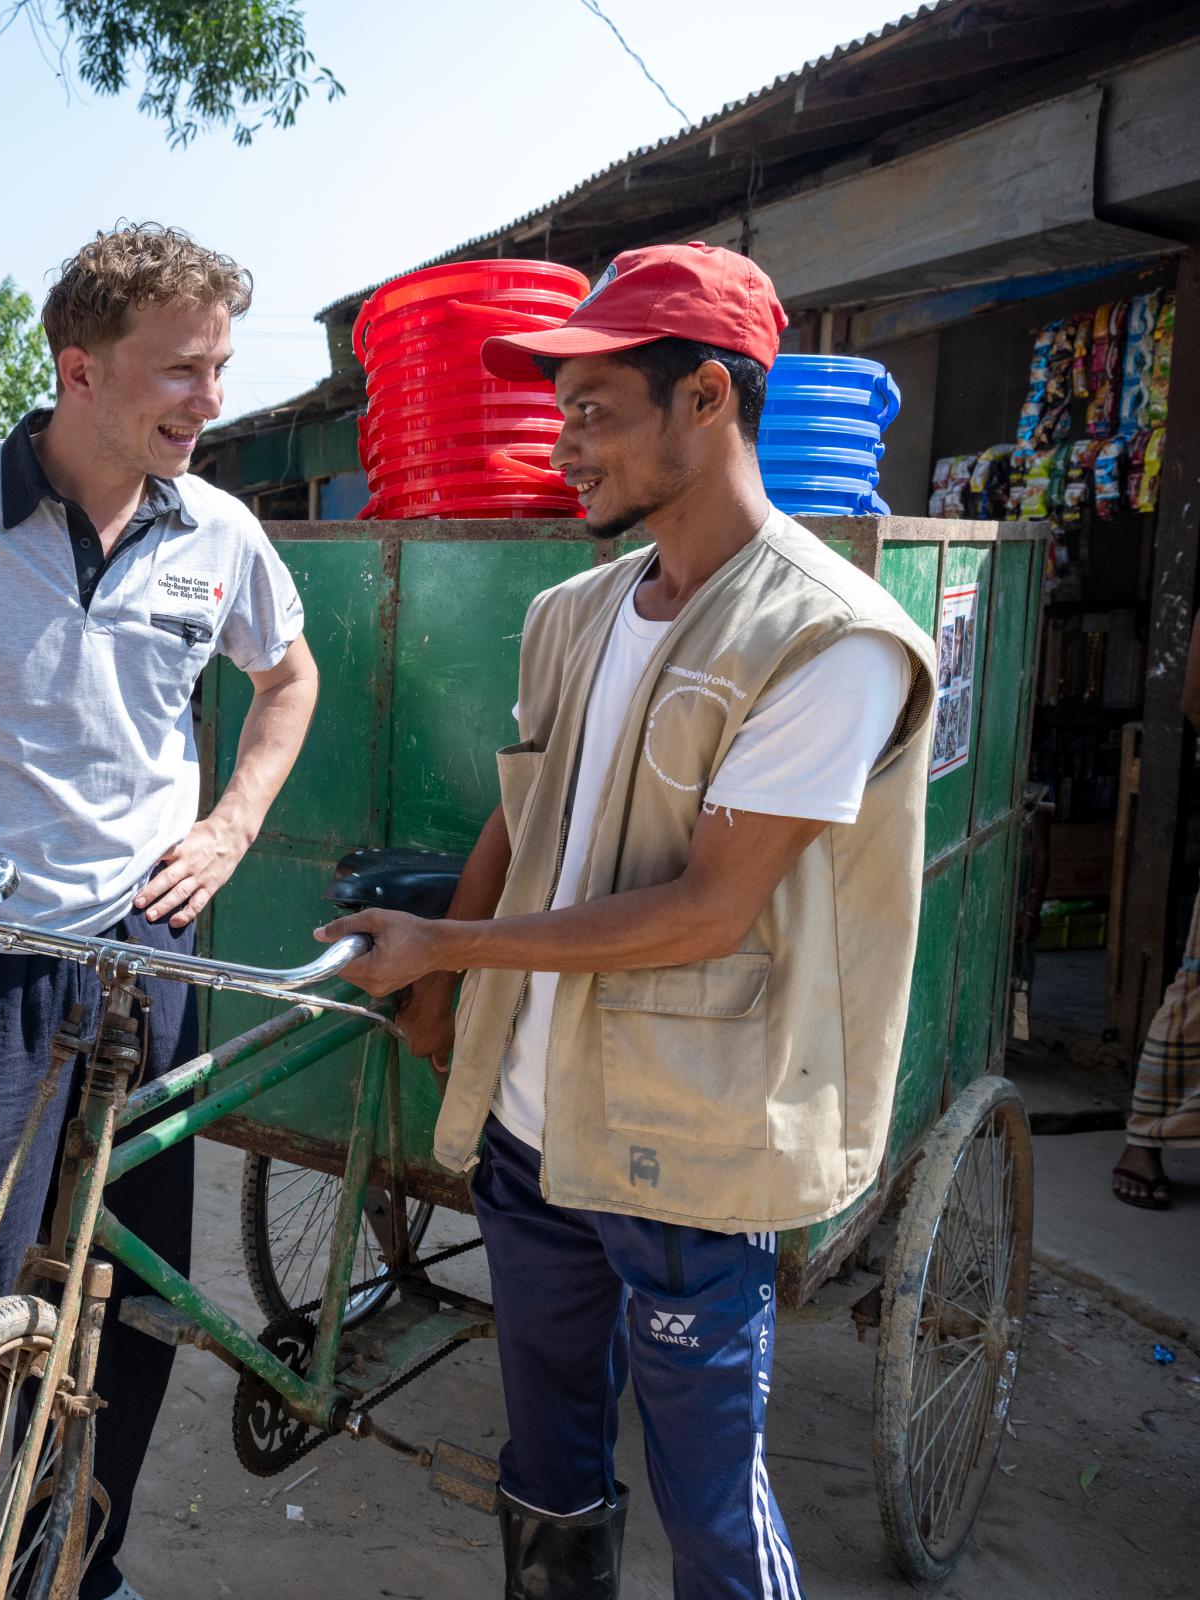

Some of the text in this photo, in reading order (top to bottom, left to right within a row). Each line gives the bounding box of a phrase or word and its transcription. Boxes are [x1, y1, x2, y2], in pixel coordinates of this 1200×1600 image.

[158, 579, 209, 594] Croix-Rouge suisse
[165, 573, 209, 587] Swiss Red Cross
[166, 588, 209, 602] Cruz Roja Suiza
[664, 777, 698, 792] Crescent
[650, 1330, 700, 1348] YONEX
